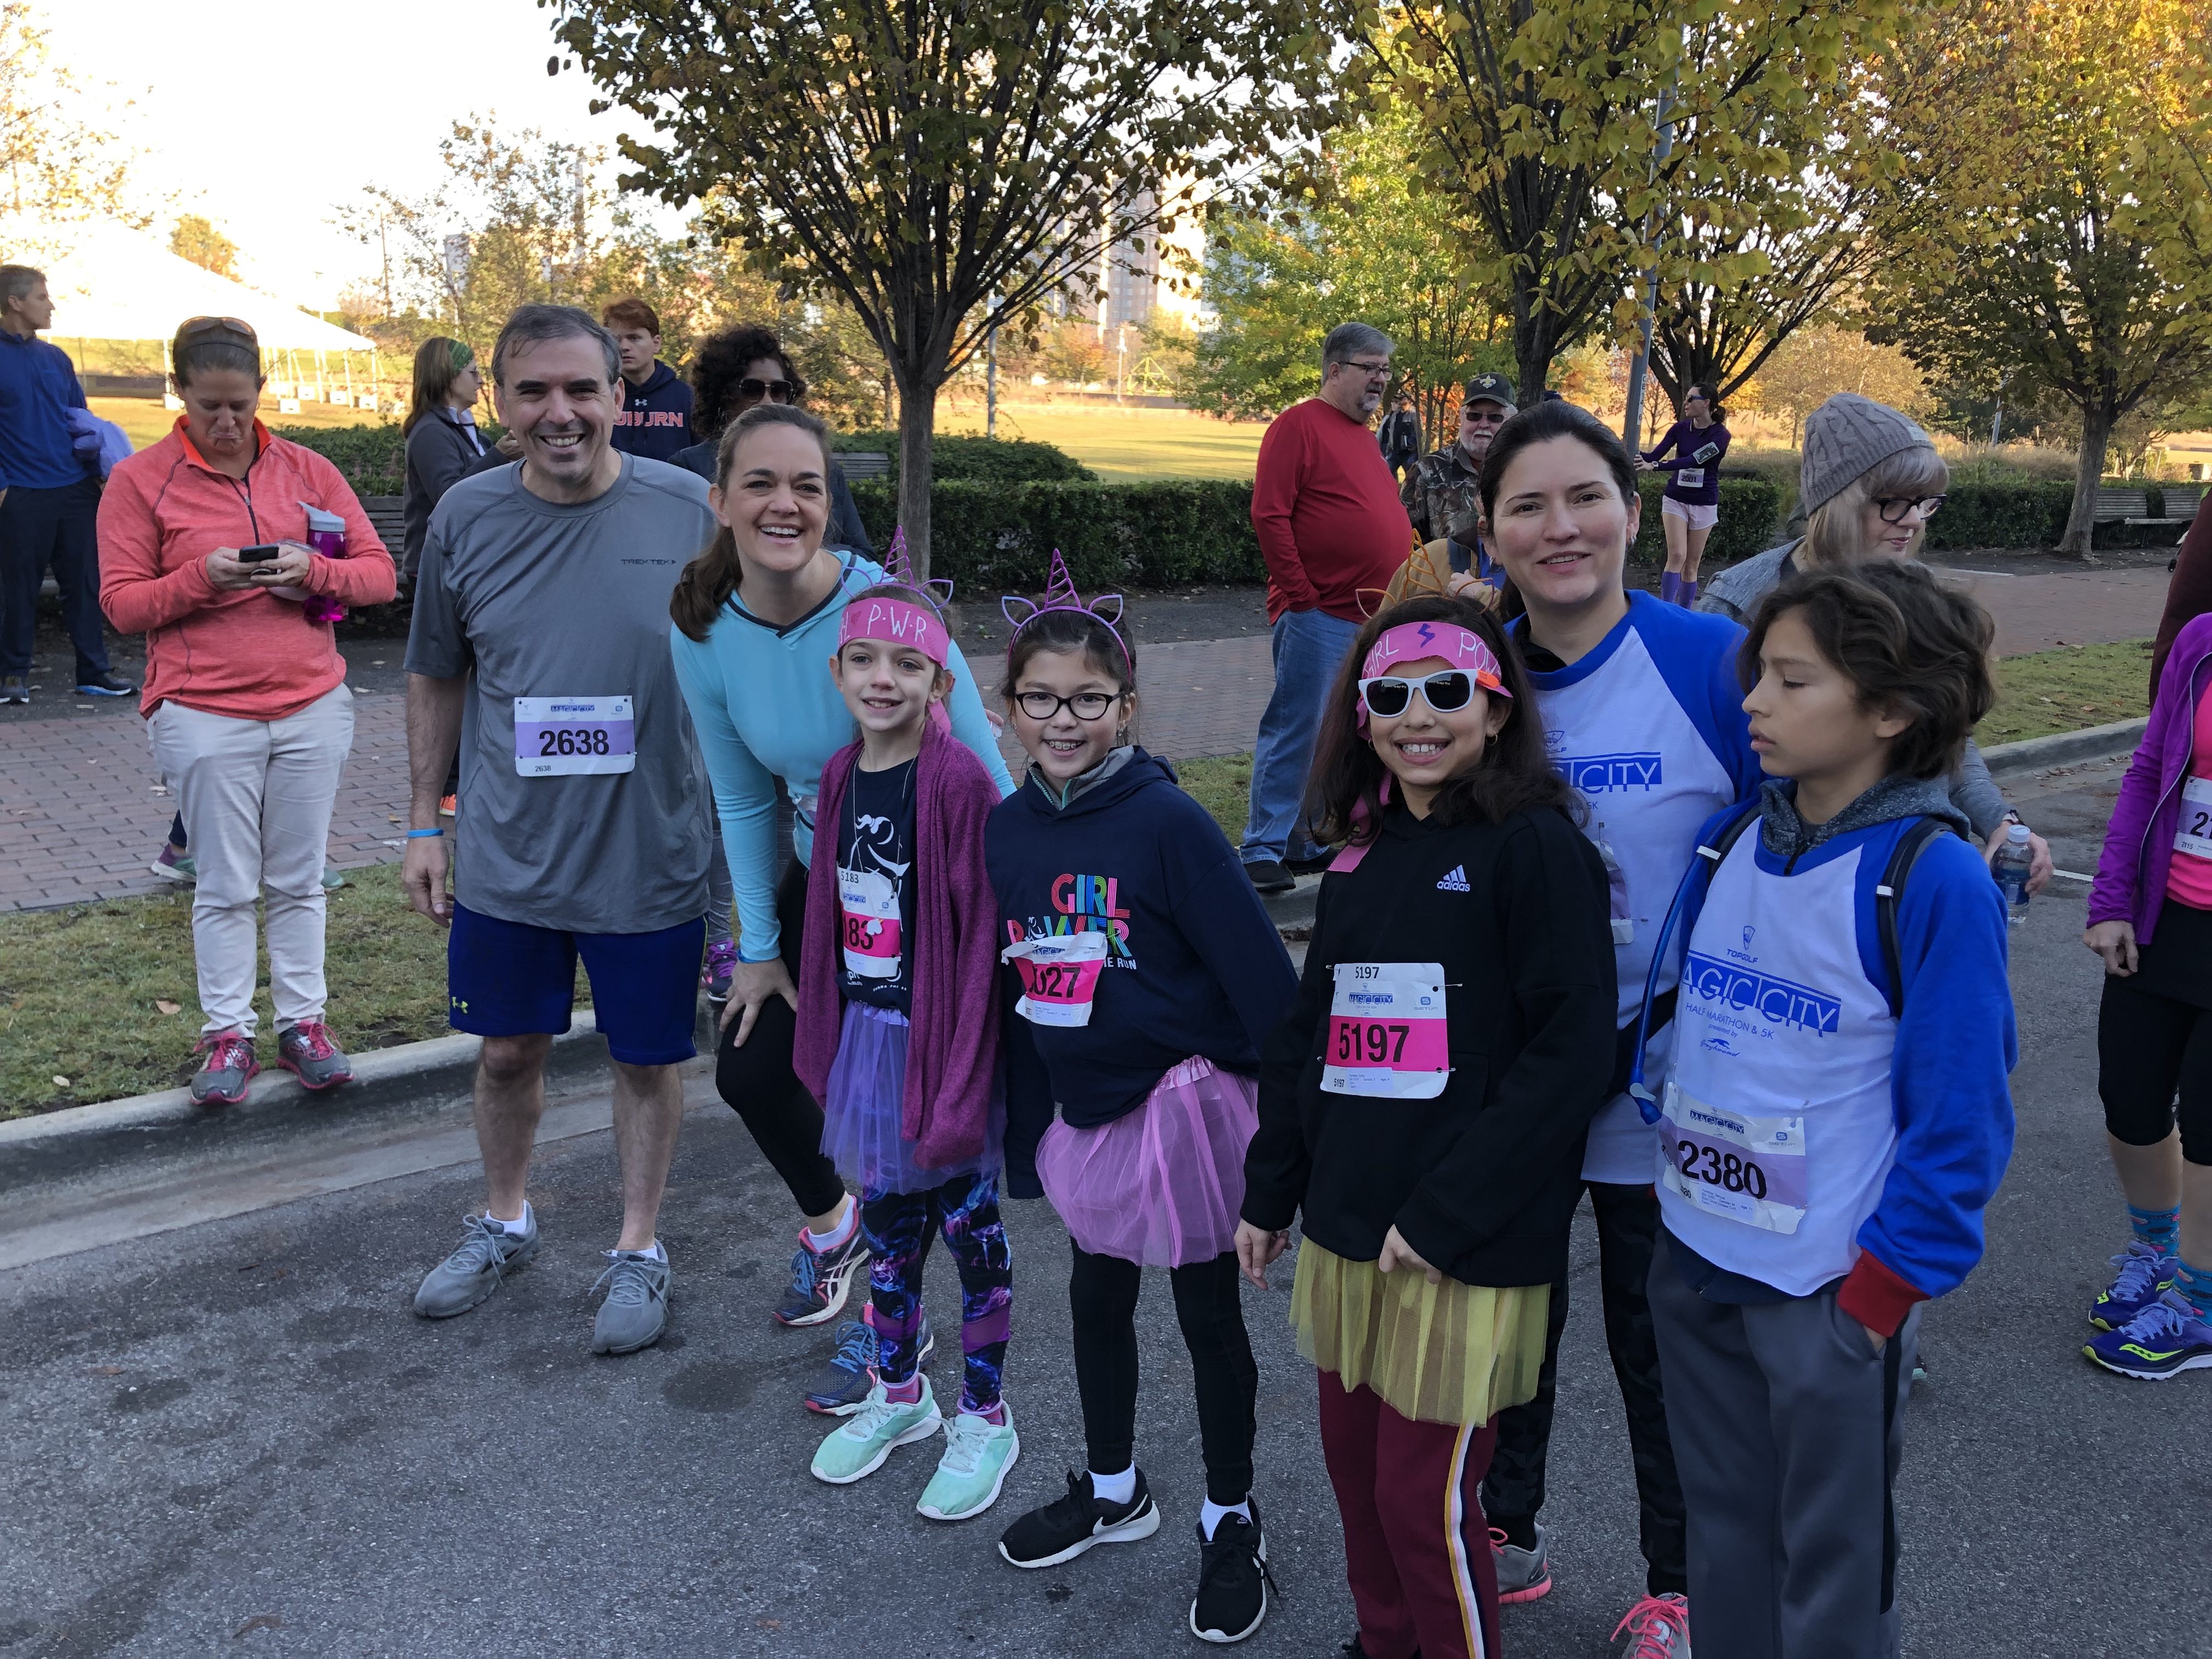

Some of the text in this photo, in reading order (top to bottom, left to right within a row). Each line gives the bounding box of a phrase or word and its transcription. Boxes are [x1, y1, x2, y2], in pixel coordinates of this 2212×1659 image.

[613, 411, 684, 427] UBURN
[539, 729, 610, 756] 2638
[1578, 761, 1658, 793] CITY
[841, 871, 859, 884] 5183
[1436, 880, 1470, 892] adidas
[1051, 873, 1130, 918] GIRL
[1117, 957, 1137, 970] RUN
[1726, 948, 1759, 964] TOPGOLF
[1355, 966, 1380, 979] 5197
[1348, 994, 1393, 1005] MAGIC CITY
[1681, 959, 1837, 1038] AGIC CITY
[1685, 1002, 1775, 1040] HALF MARATHON & 5K
[1708, 1023, 1739, 1038] presented by
[1338, 1023, 1410, 1063] 5197
[1334, 1078, 1345, 1088] 5197
[1690, 1110, 1745, 1135] MAGIC CITY
[1678, 1140, 1767, 1200] 2380
